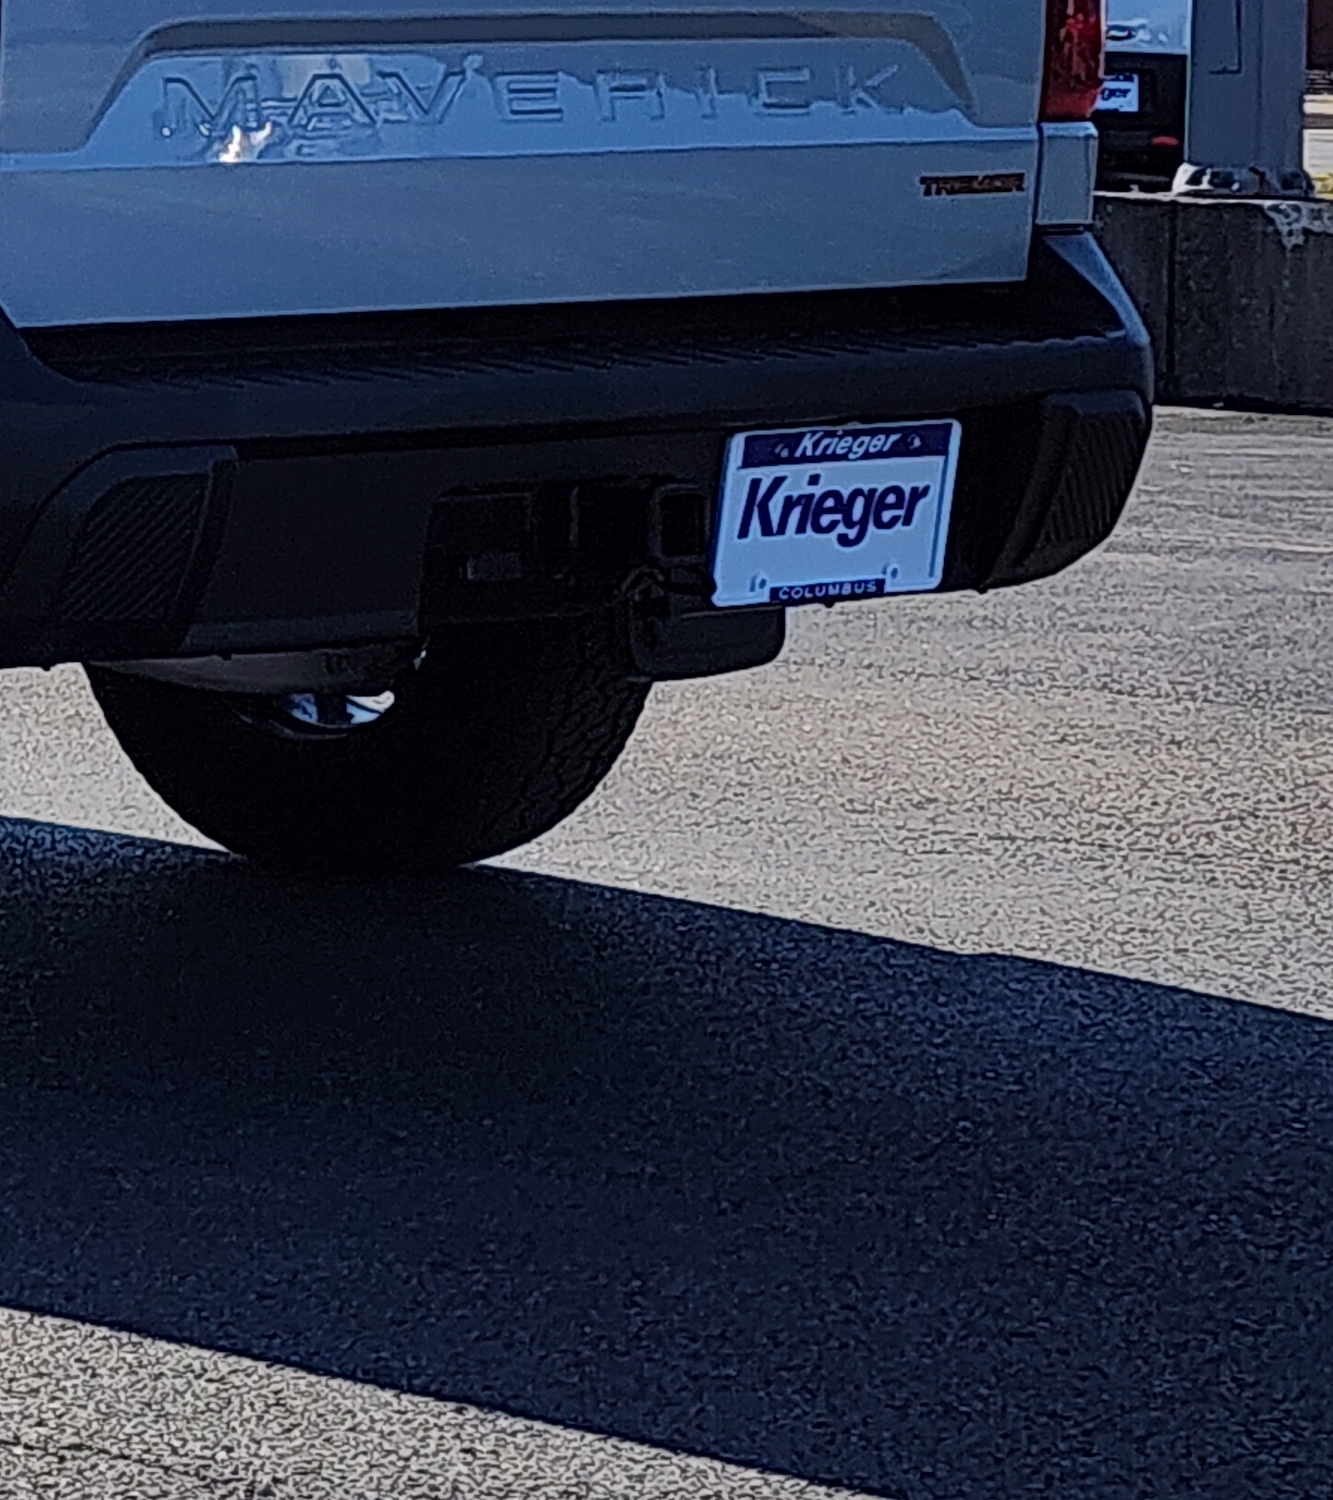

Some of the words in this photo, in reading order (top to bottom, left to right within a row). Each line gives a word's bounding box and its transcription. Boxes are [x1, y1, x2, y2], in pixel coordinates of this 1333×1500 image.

[160, 64, 905, 138] MAVERICK
[794, 430, 903, 460] Krieger
[737, 473, 931, 548] Krieger
[778, 581, 878, 600] COLUMBUS
